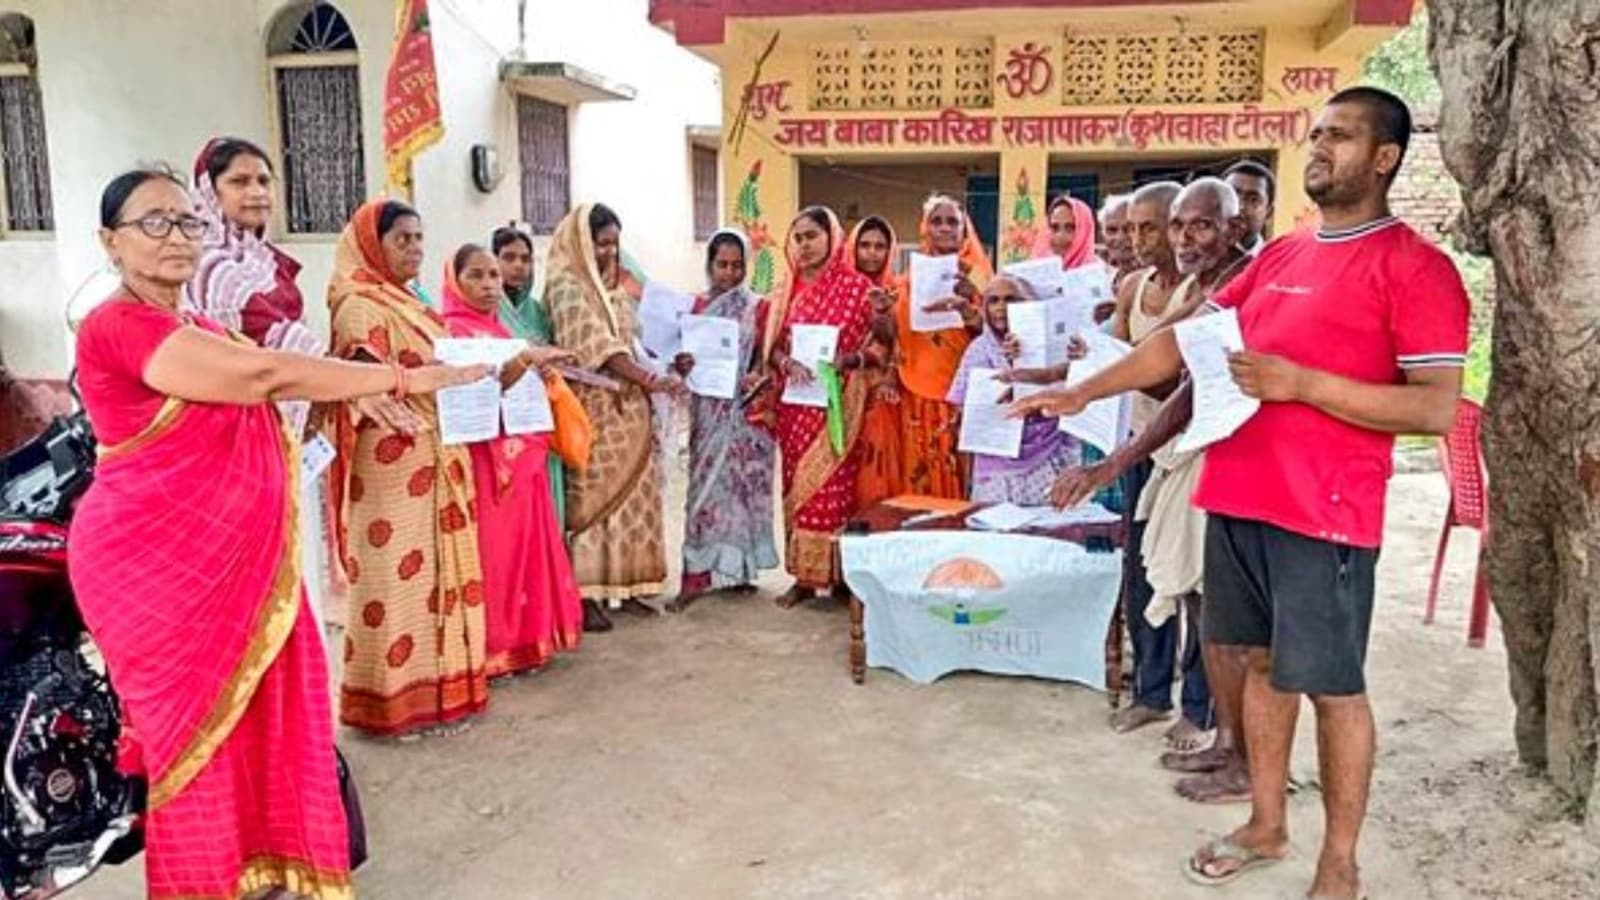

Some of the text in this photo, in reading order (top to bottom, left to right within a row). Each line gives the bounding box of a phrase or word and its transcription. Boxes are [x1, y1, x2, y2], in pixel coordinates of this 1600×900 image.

[774, 119, 830, 147] जय
[835, 118, 899, 147] बाबा
[902, 106, 998, 147] कारिख
